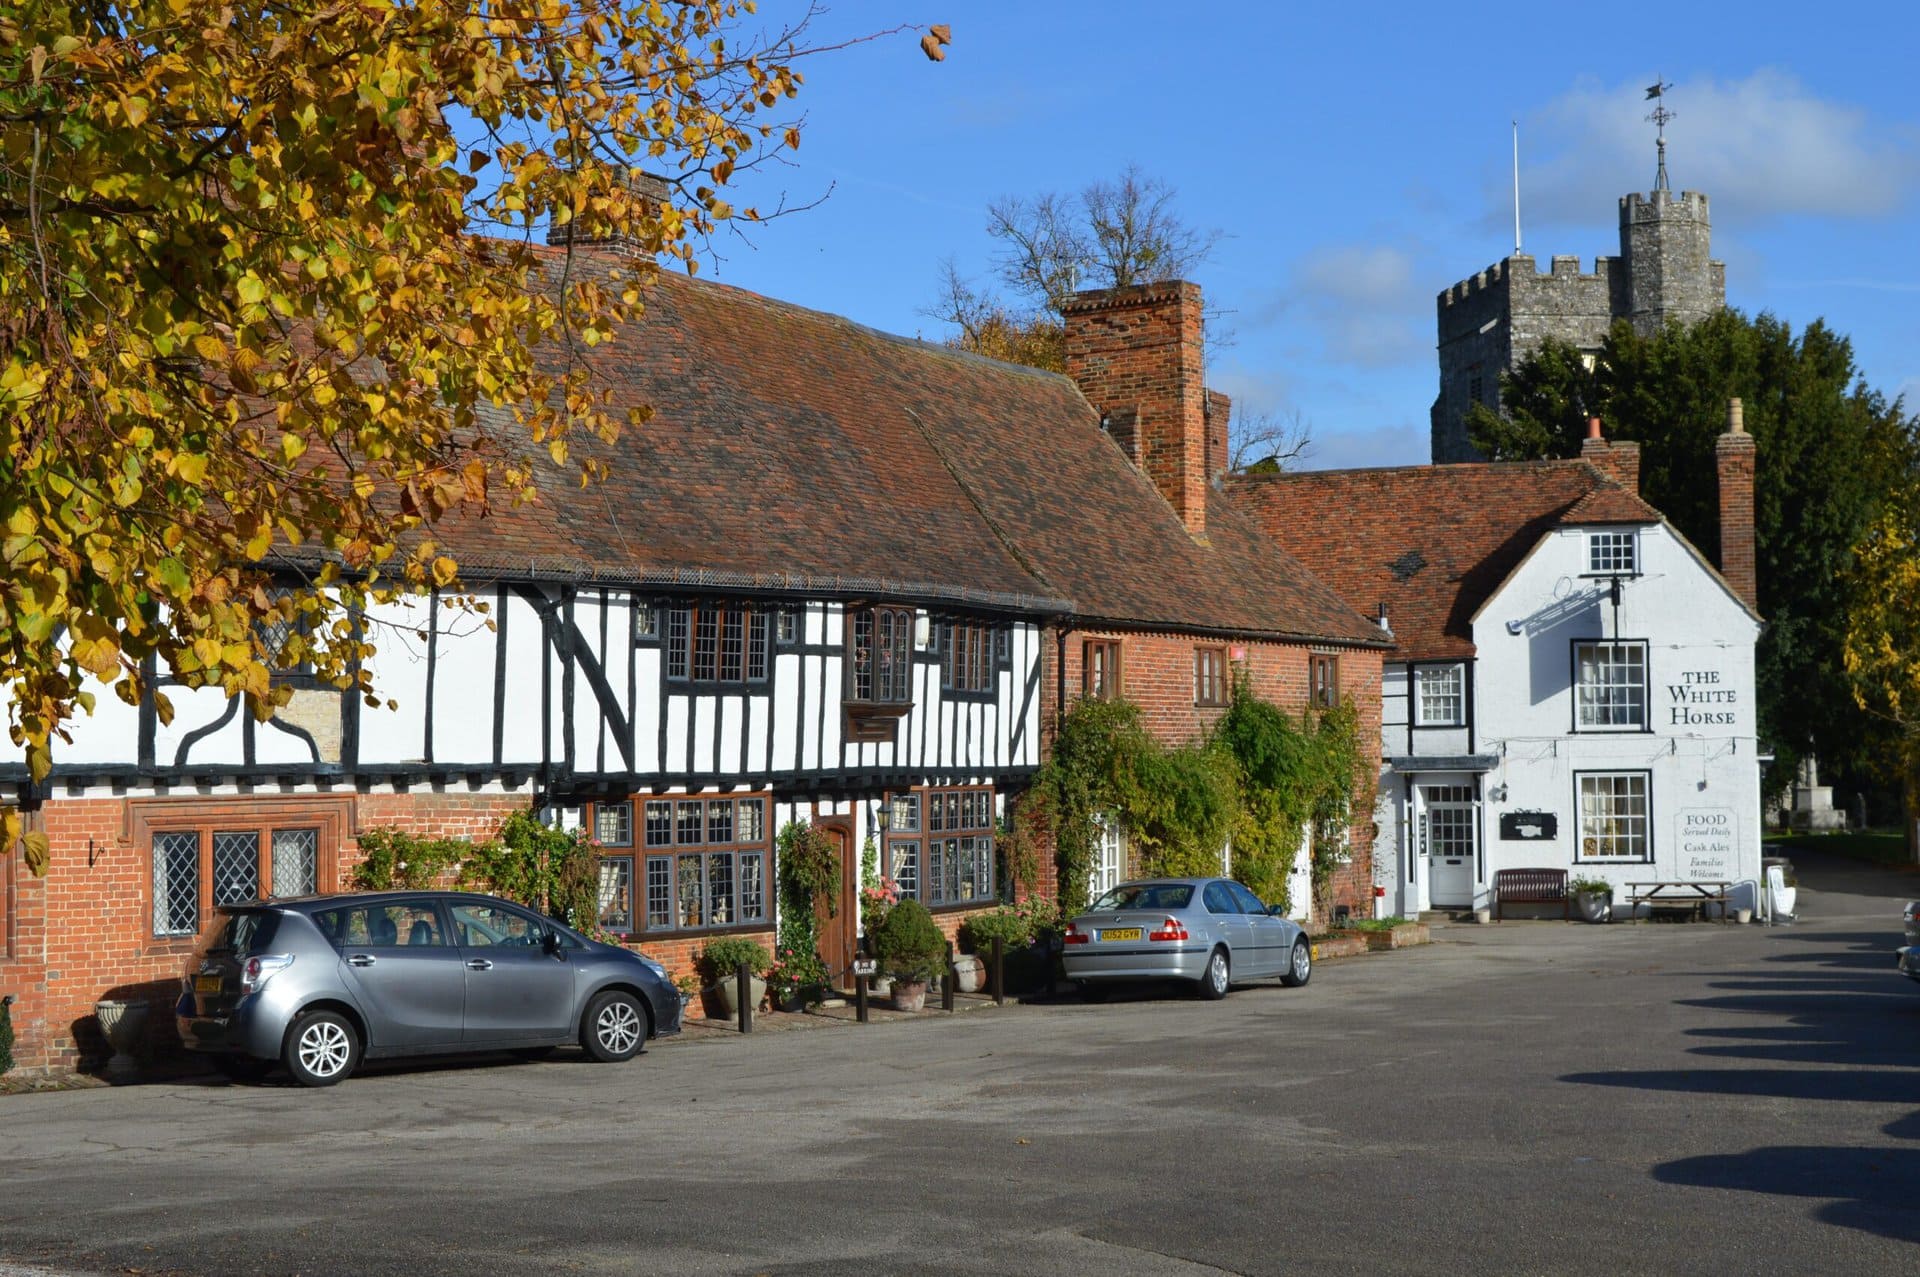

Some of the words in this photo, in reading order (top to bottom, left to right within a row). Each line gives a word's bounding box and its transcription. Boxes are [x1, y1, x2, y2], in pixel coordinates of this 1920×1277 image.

[1682, 672, 1720, 683] THE
[1667, 685, 1736, 702] WHITE
[1669, 707, 1735, 724] HORSE
[1687, 815, 1726, 825] FOOD
[1682, 827, 1709, 836] Served
[1711, 827, 1730, 838] Daily
[1684, 843, 1706, 852] Cask
[1710, 843, 1729, 852] Ales
[1690, 857, 1724, 867] Families
[1690, 870, 1724, 878] Welcome
